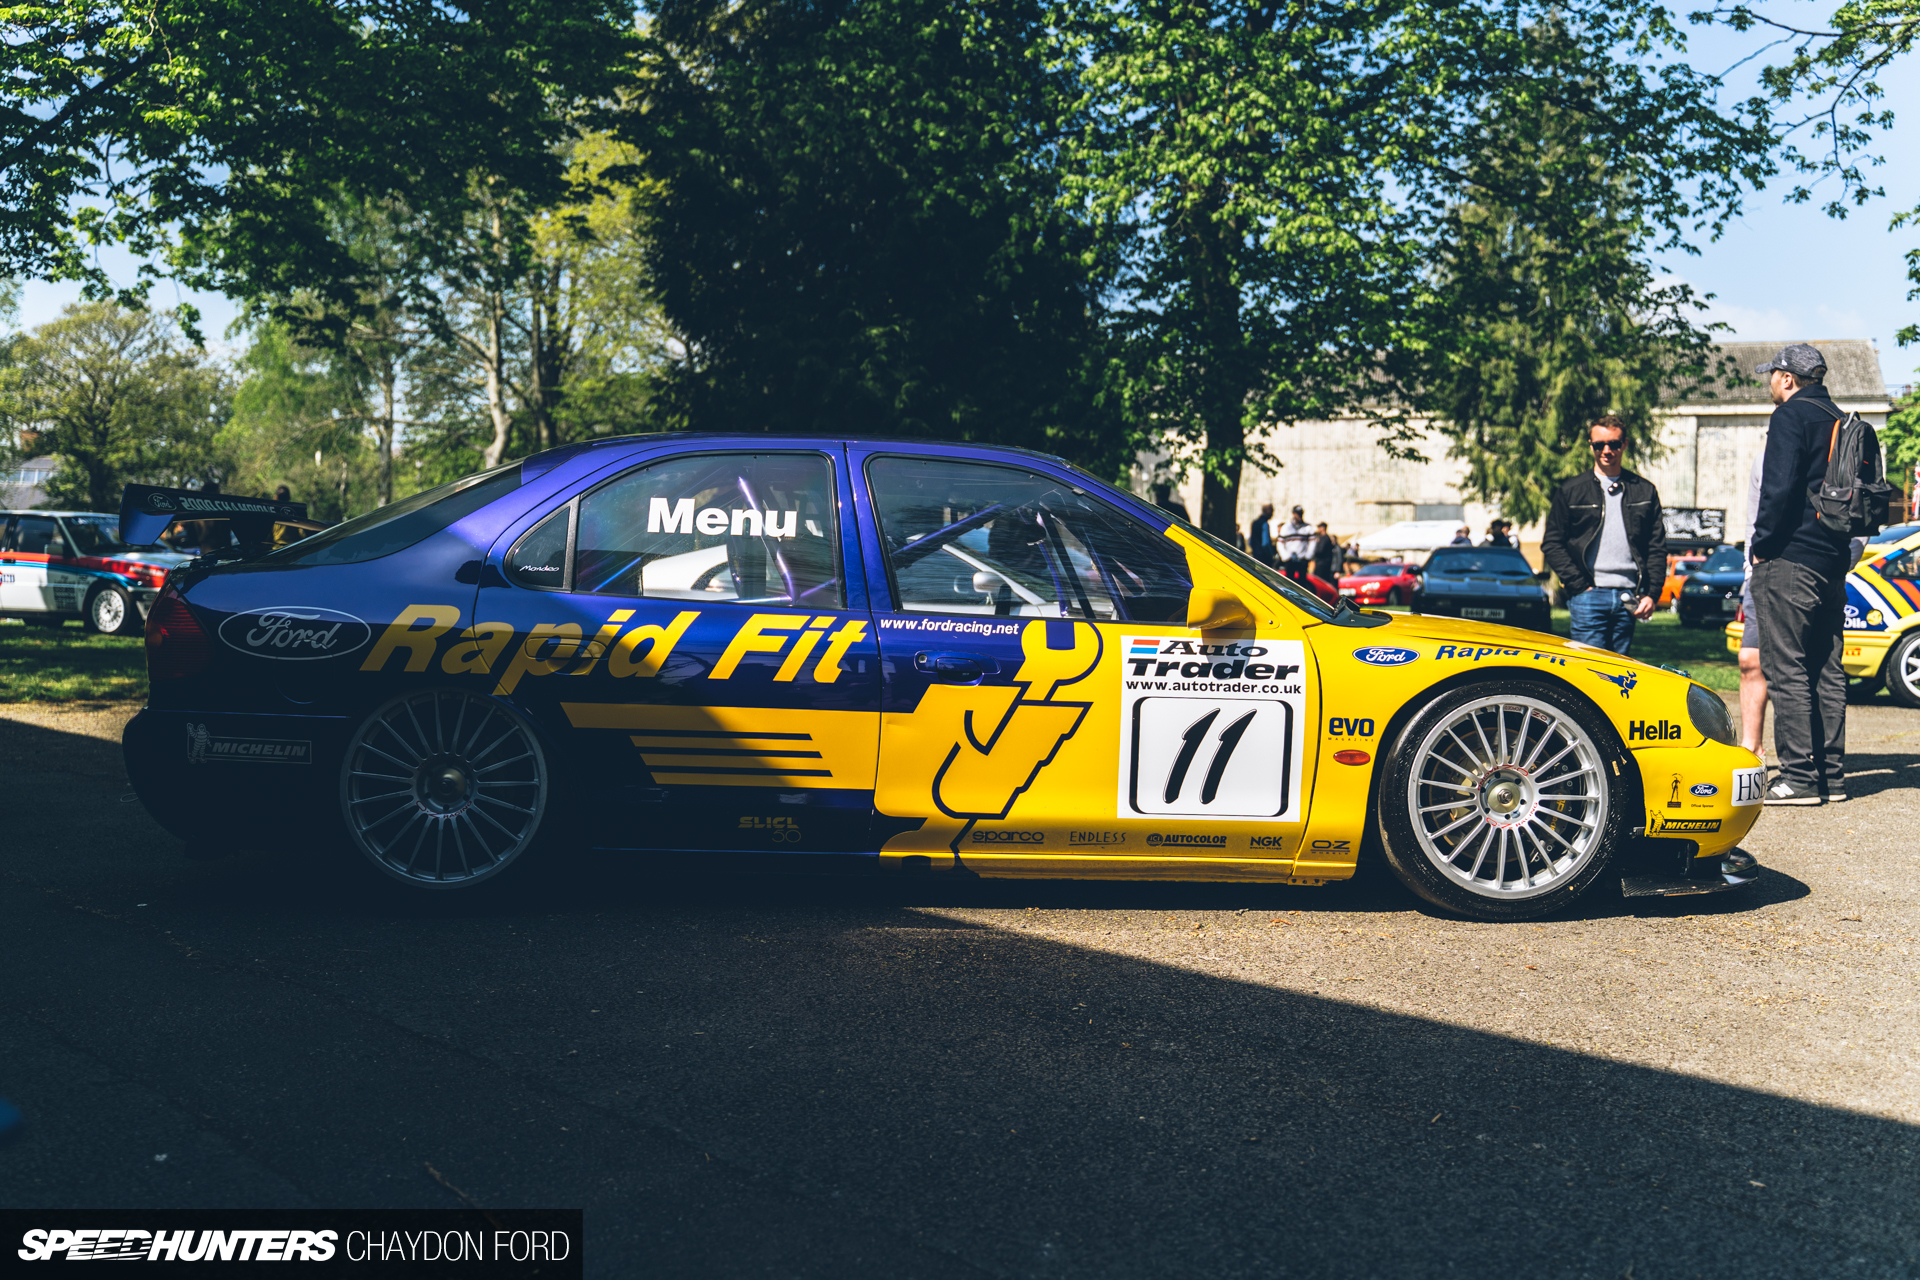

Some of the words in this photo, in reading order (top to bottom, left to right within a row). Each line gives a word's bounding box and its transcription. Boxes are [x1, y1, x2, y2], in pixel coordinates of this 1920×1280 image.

[647, 497, 797, 537] Menu
[519, 564, 560, 572] Mondeo
[247, 611, 342, 649] Ford
[880, 618, 1019, 636] www.fordracing.net
[359, 604, 702, 695] Rapid
[707, 613, 869, 684] Fit
[1160, 640, 1268, 657] Auto
[1366, 648, 1406, 662] Ford
[1435, 645, 1520, 661] Rapid
[1533, 653, 1567, 666] Fit
[1127, 658, 1300, 680] Trader
[1126, 681, 1301, 695] www.autotrader.co.uk
[1329, 718, 1375, 736] evo
[1629, 720, 1681, 740] Hella
[212, 742, 306, 756] MICHELIN
[1163, 708, 1257, 804] 11
[1695, 785, 1714, 796] Ford
[1736, 773, 1766, 801] HSB
[772, 829, 802, 843] 50
[972, 831, 1044, 843] sparco
[1070, 831, 1126, 843] ENDLESS
[1164, 834, 1227, 845] AUTOCOLOR
[1250, 836, 1282, 847] NGK
